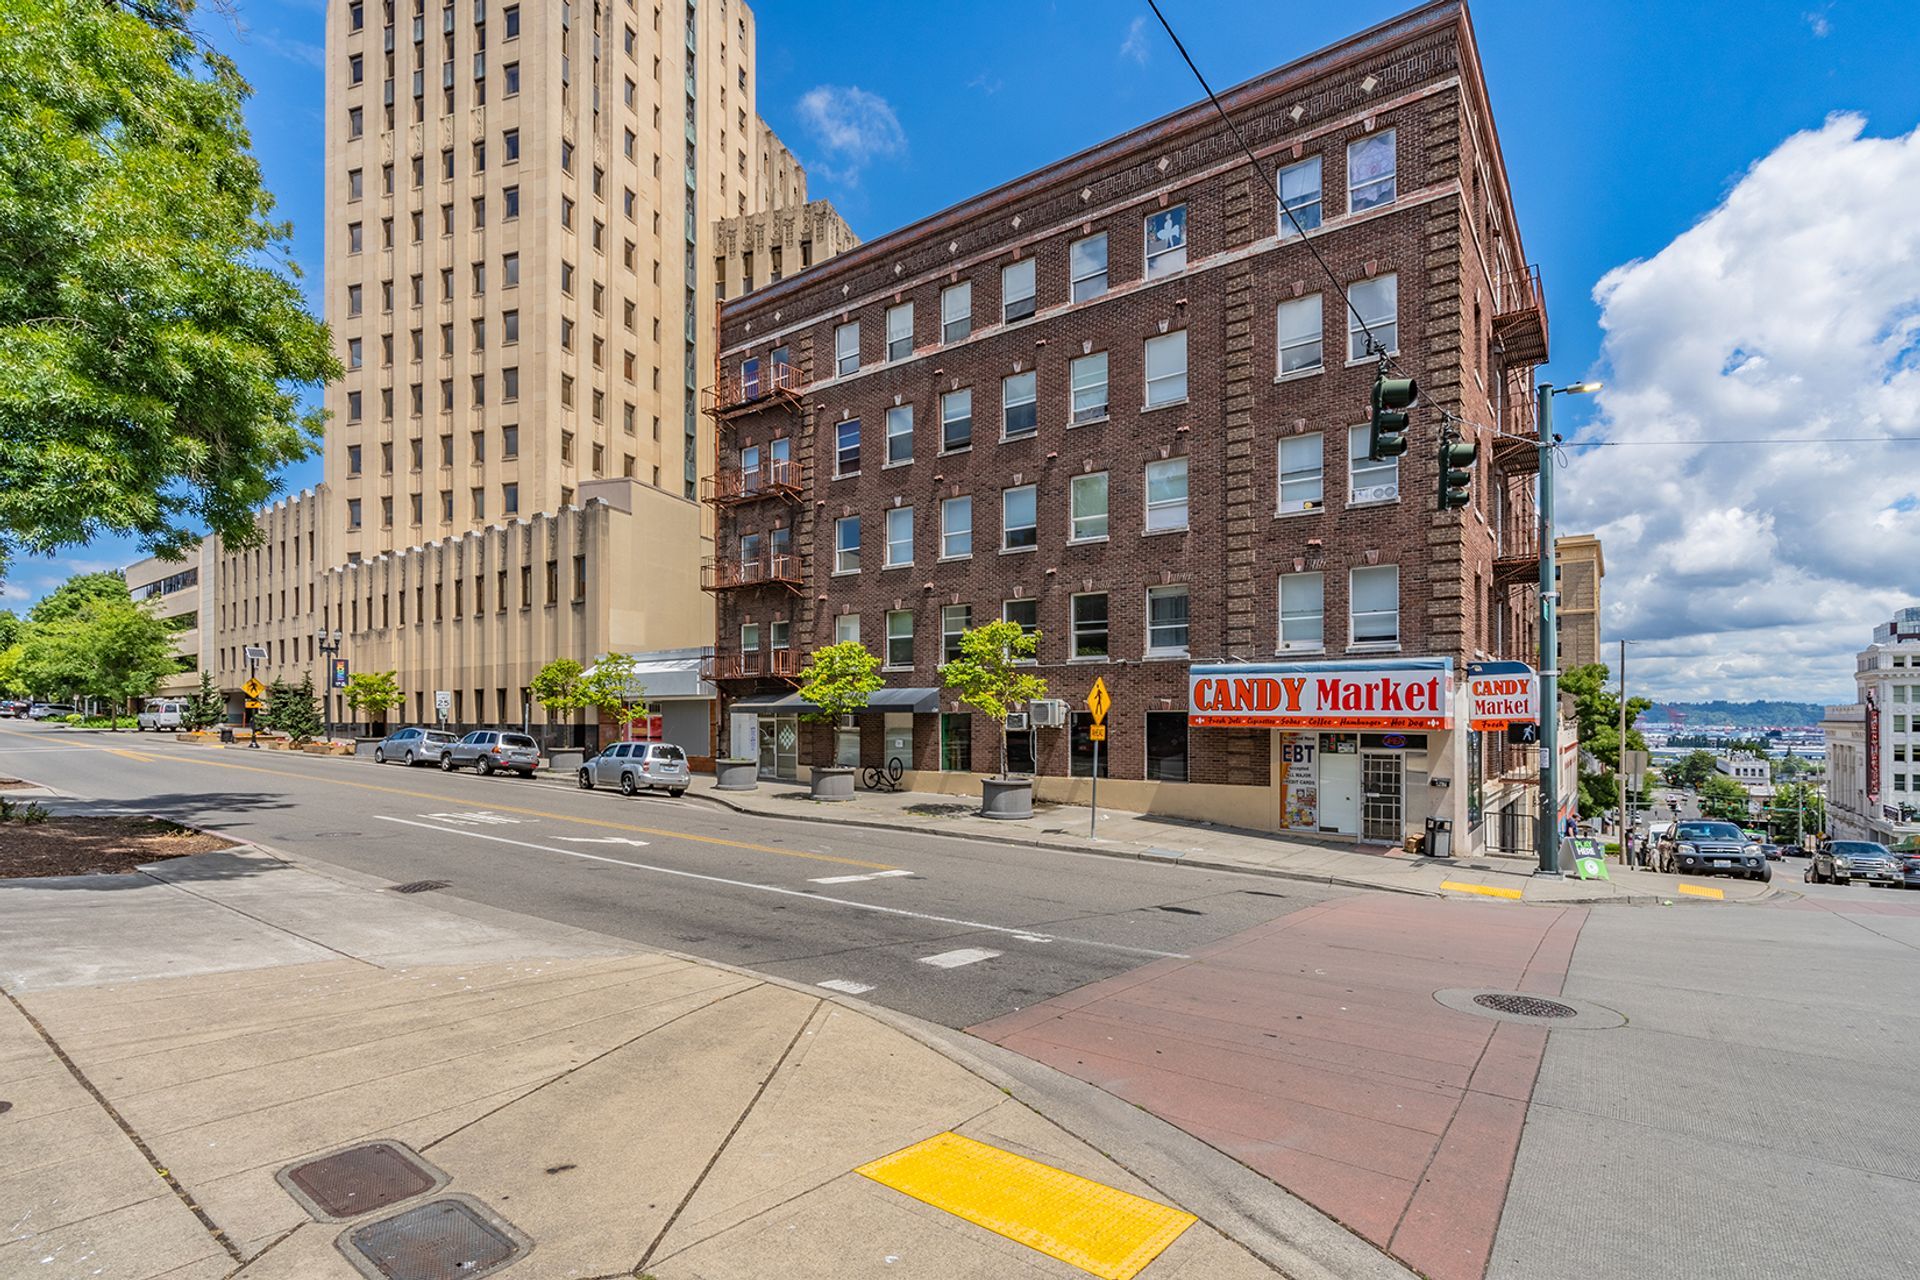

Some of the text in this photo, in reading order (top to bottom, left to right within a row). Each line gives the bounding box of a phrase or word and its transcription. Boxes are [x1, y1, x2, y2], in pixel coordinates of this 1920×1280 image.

[1193, 677, 1307, 712] CANDY
[1316, 677, 1440, 712] Market
[1472, 678, 1530, 696] CANDY
[1475, 698, 1529, 715] Market
[1308, 717, 1332, 726] Coffee
[1390, 717, 1406, 727] Hot
[1481, 720, 1504, 729] Fresh
[1283, 744, 1315, 763] EBT
